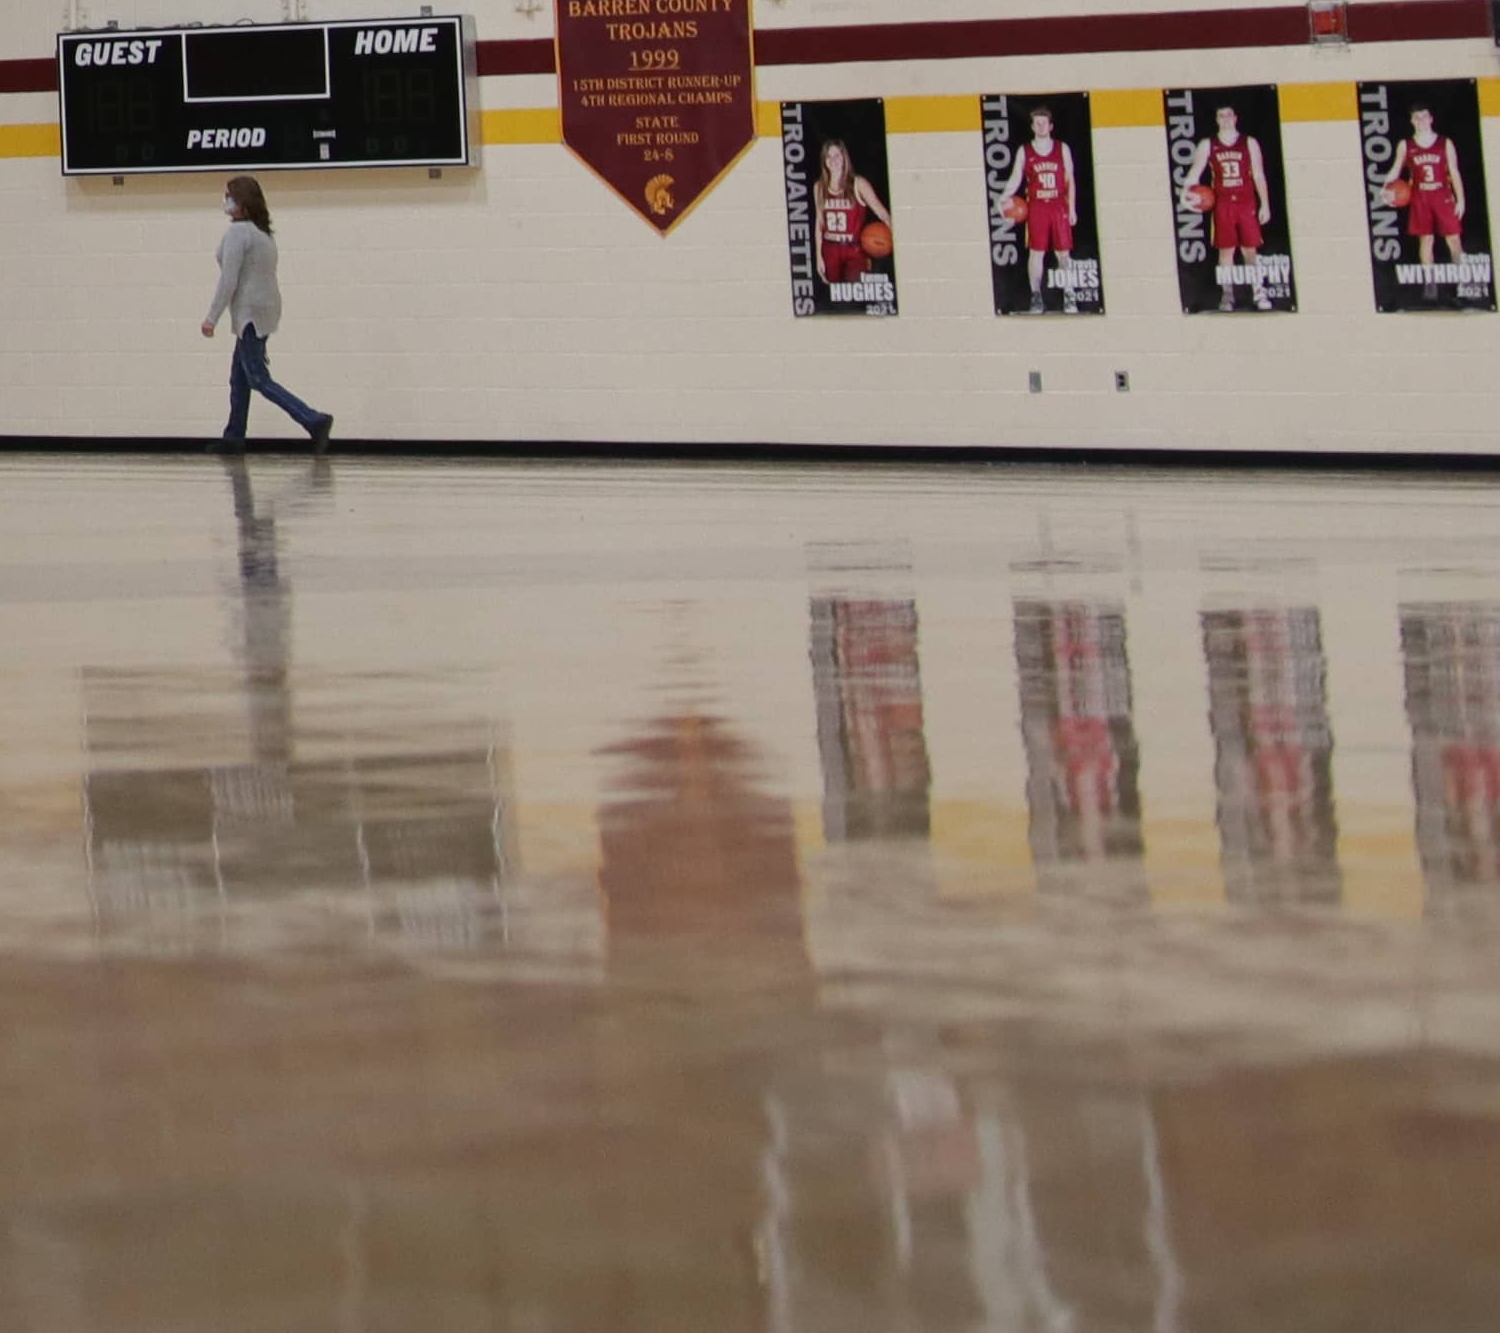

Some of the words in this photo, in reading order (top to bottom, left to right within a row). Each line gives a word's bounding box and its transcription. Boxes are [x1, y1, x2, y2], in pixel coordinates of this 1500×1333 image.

[605, 20, 699, 41] TROJANS
[354, 27, 439, 56] HOME
[74, 39, 162, 67] GUEST
[628, 48, 681, 71] 1999
[573, 78, 605, 92] 15TH
[607, 76, 664, 90] DISTRICT
[667, 74, 741, 89] RUNNER-UP
[580, 94, 606, 107] 4TH
[608, 93, 675, 107] REGIONAL
[678, 91, 734, 104] CHAMPS
[635, 116, 680, 129] STATE
[185, 128, 267, 150] PERIOD
[616, 133, 653, 146] FIRST
[656, 132, 700, 145] ROUND
[982, 94, 1019, 267] TROJANS
[1221, 161, 1241, 179] 33
[1360, 85, 1402, 262] TROJANS
[1423, 164, 1435, 182] 3
[783, 103, 816, 316] TROJANETTES
[826, 211, 848, 233] 23
[1046, 268, 1101, 289] JONES
[1215, 265, 1291, 286] MURPHY
[1395, 263, 1492, 285] WITHROW
[829, 283, 895, 303] HUGHES
